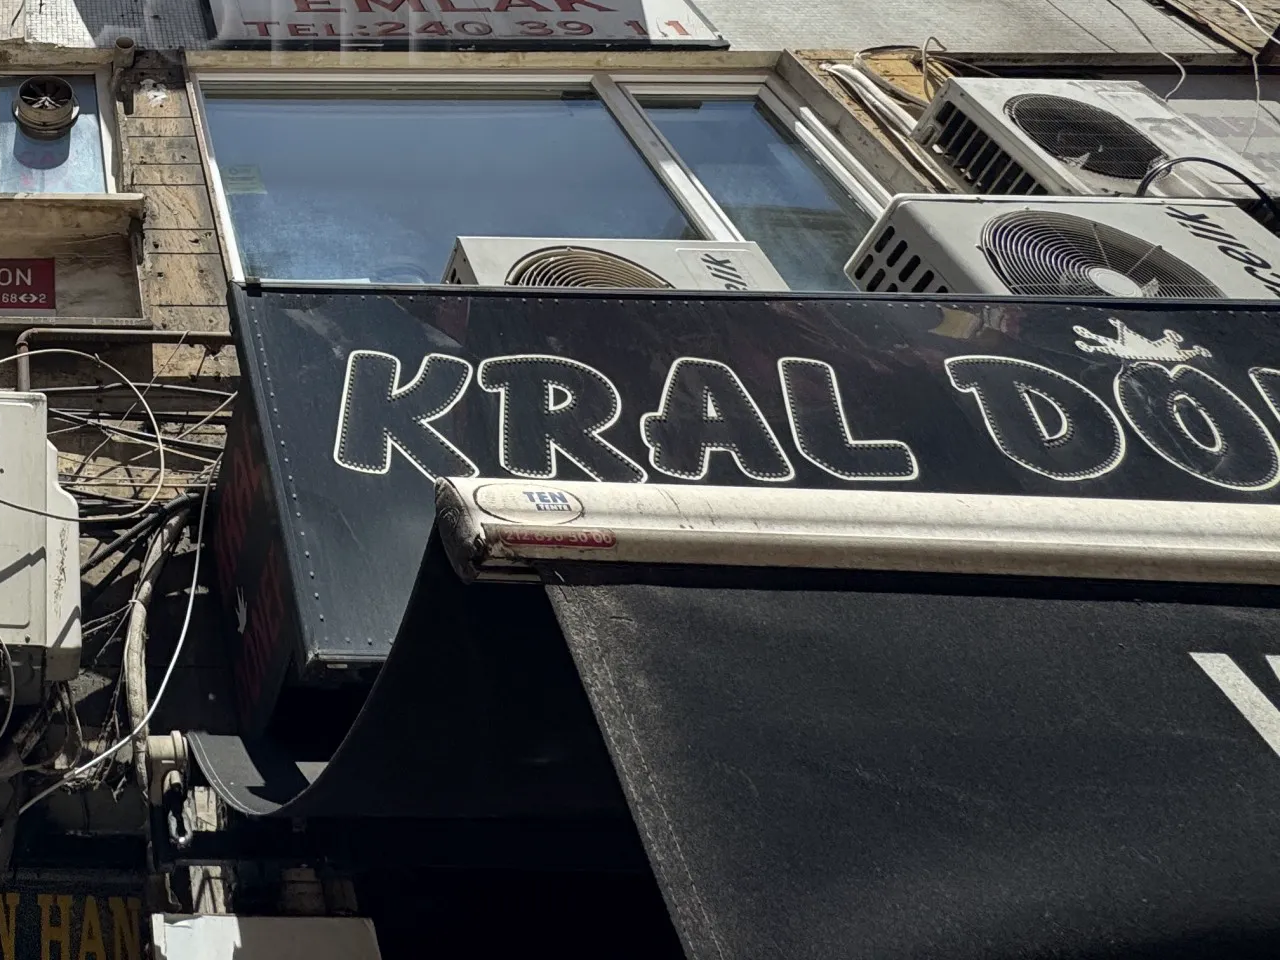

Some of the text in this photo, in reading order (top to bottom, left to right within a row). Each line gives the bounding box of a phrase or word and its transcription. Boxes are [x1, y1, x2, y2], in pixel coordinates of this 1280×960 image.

[519, 20, 596, 38] 39
[333, 349, 1280, 491] KRAL DÖ
